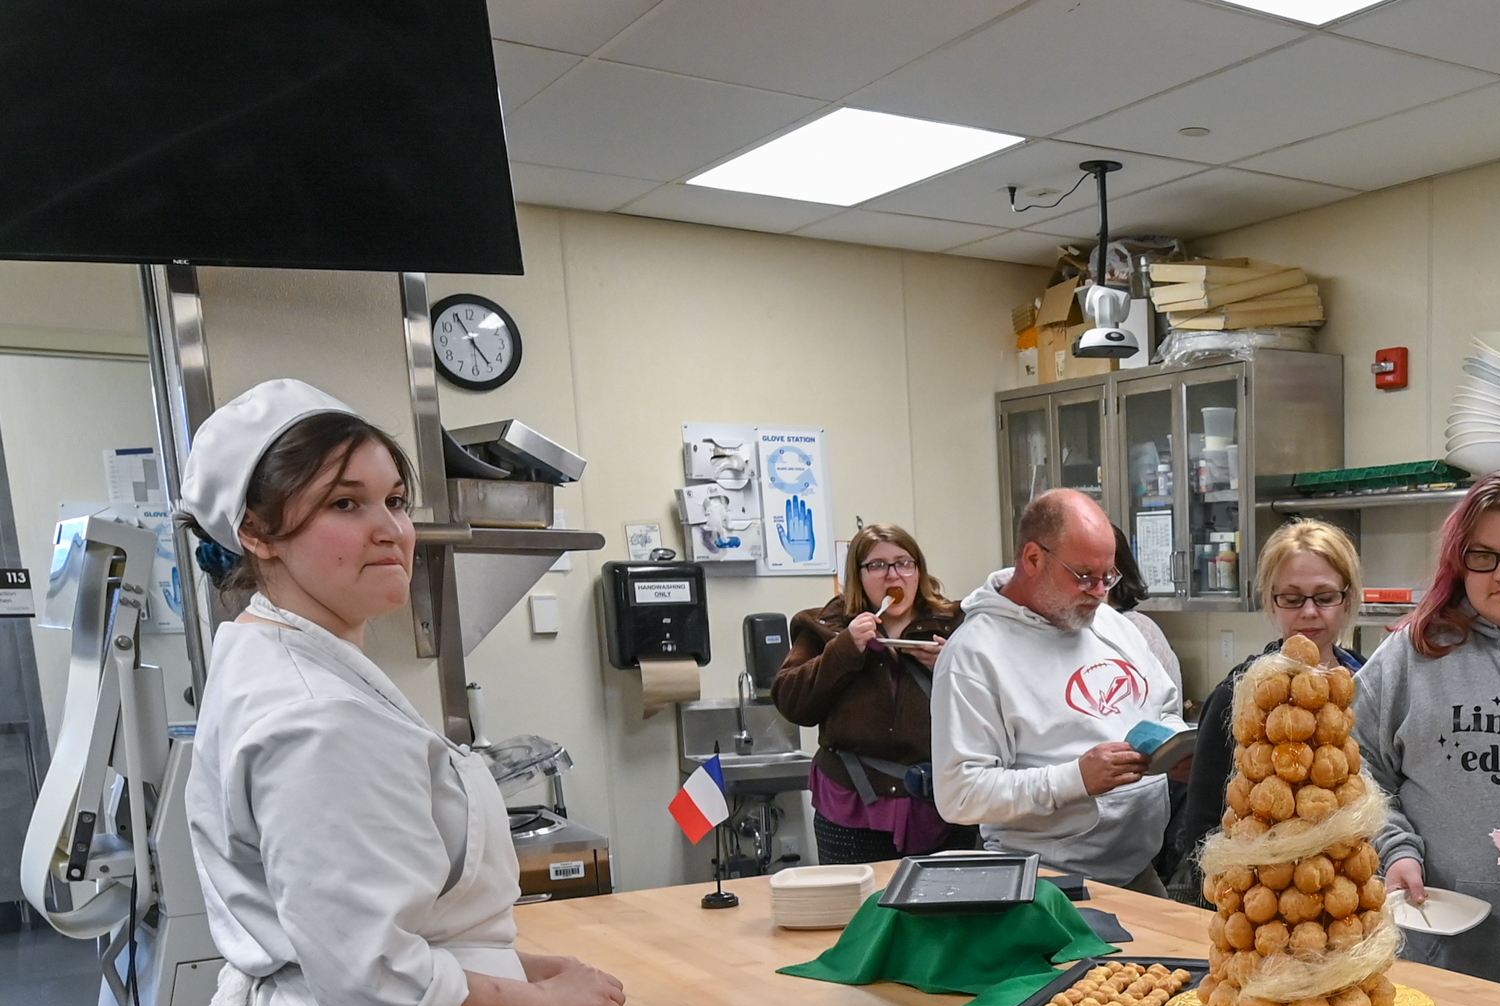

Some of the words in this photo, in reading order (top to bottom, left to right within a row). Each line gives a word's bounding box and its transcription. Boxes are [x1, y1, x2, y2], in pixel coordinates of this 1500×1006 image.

[465, 309, 474, 321] 12
[442, 321, 453, 333] 10
[440, 336, 448, 347] 9
[499, 338, 505, 350] 3
[446, 350, 453, 361] 8
[496, 352, 503, 363] 4
[458, 361, 464, 372] 7
[472, 365, 480, 376] 6
[6, 572, 26, 583] 113
